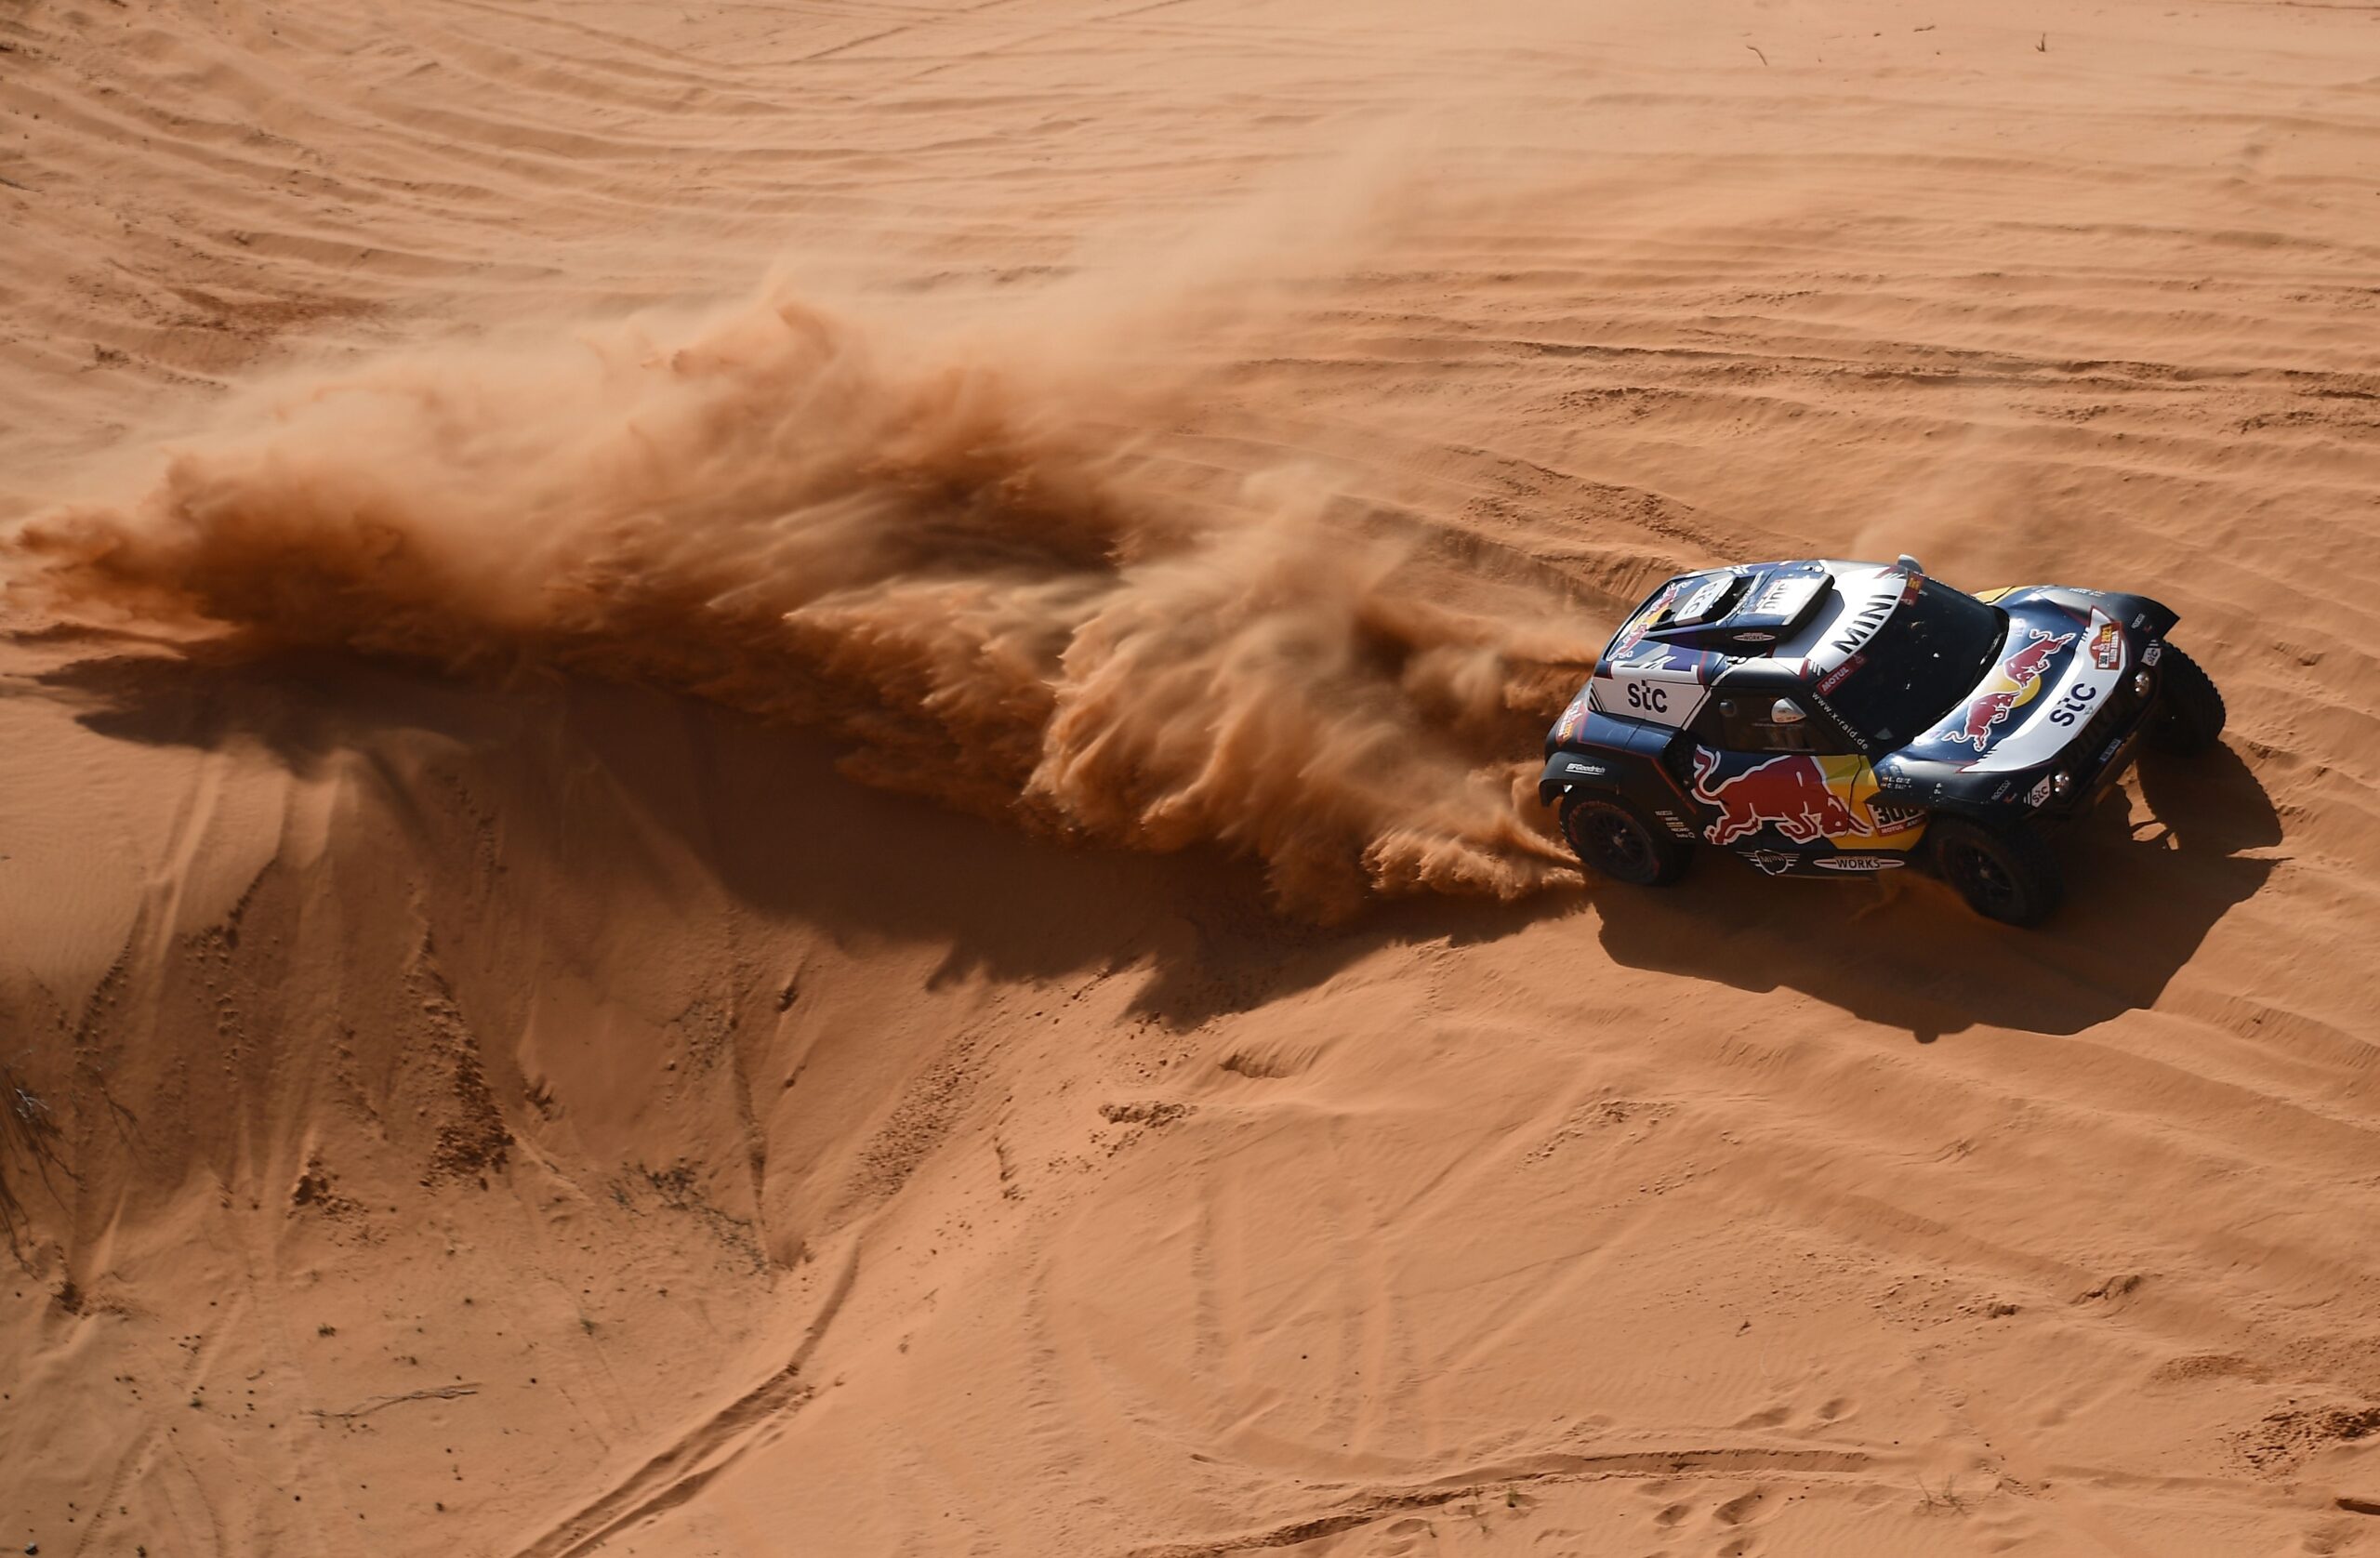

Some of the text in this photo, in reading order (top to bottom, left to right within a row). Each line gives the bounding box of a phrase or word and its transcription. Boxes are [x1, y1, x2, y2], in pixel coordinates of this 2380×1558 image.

[1831, 594, 1898, 654] MINI
[1822, 667, 1849, 692] MOTUL
[1812, 692, 1869, 750] www.x-raid.de
[1881, 824, 1905, 834] MOTUL
[1835, 858, 1881, 869] WORKS
